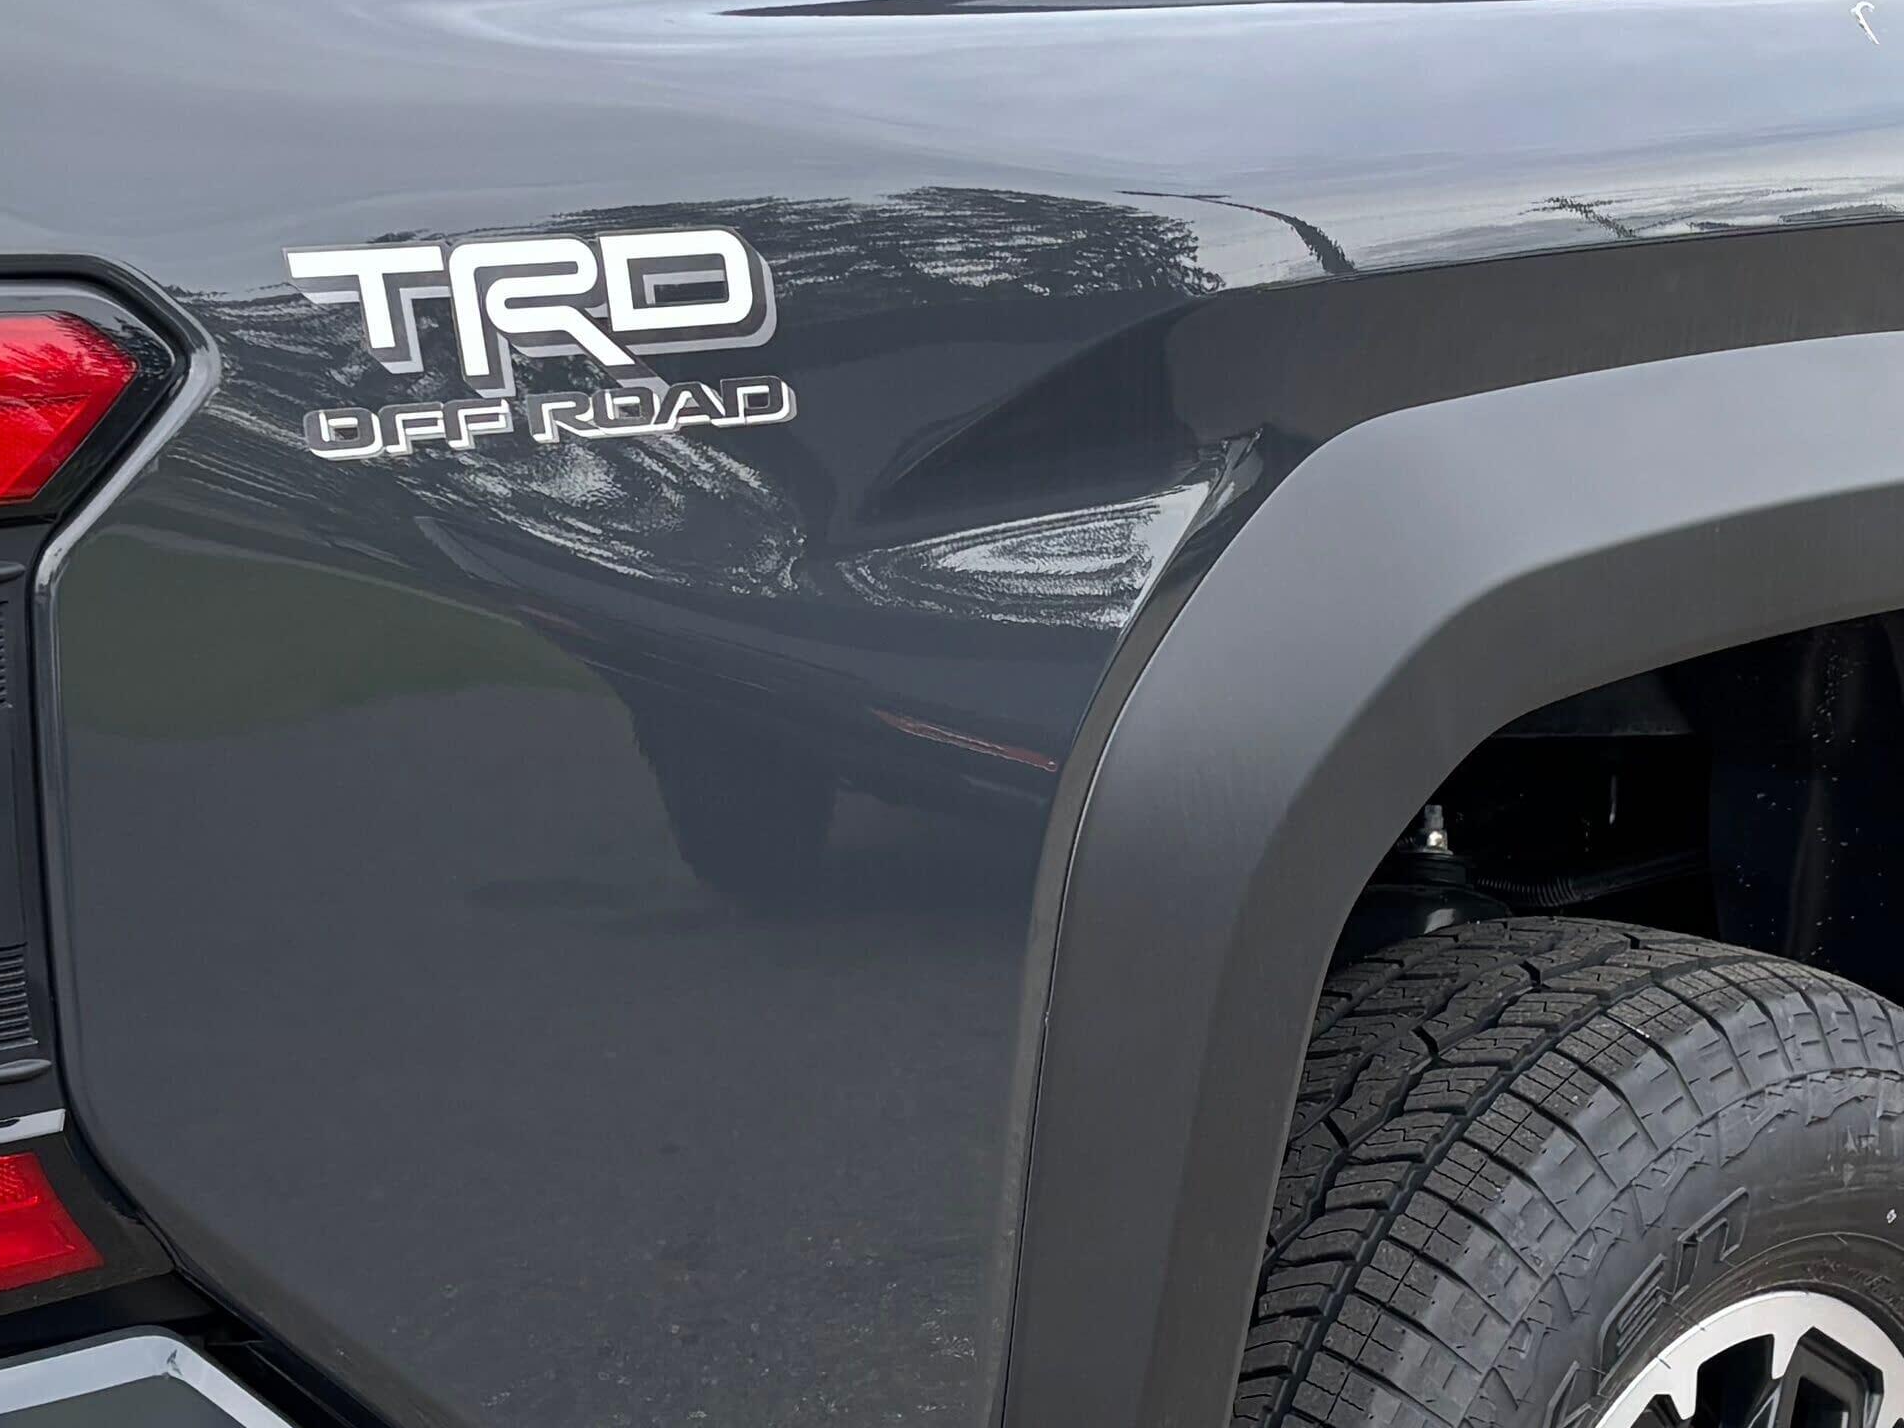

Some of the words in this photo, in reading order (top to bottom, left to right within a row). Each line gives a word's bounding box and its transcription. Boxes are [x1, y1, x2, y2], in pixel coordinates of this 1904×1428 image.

[283, 227, 778, 396] TRD
[303, 397, 514, 461] OFF
[527, 376, 797, 444] ROAD
